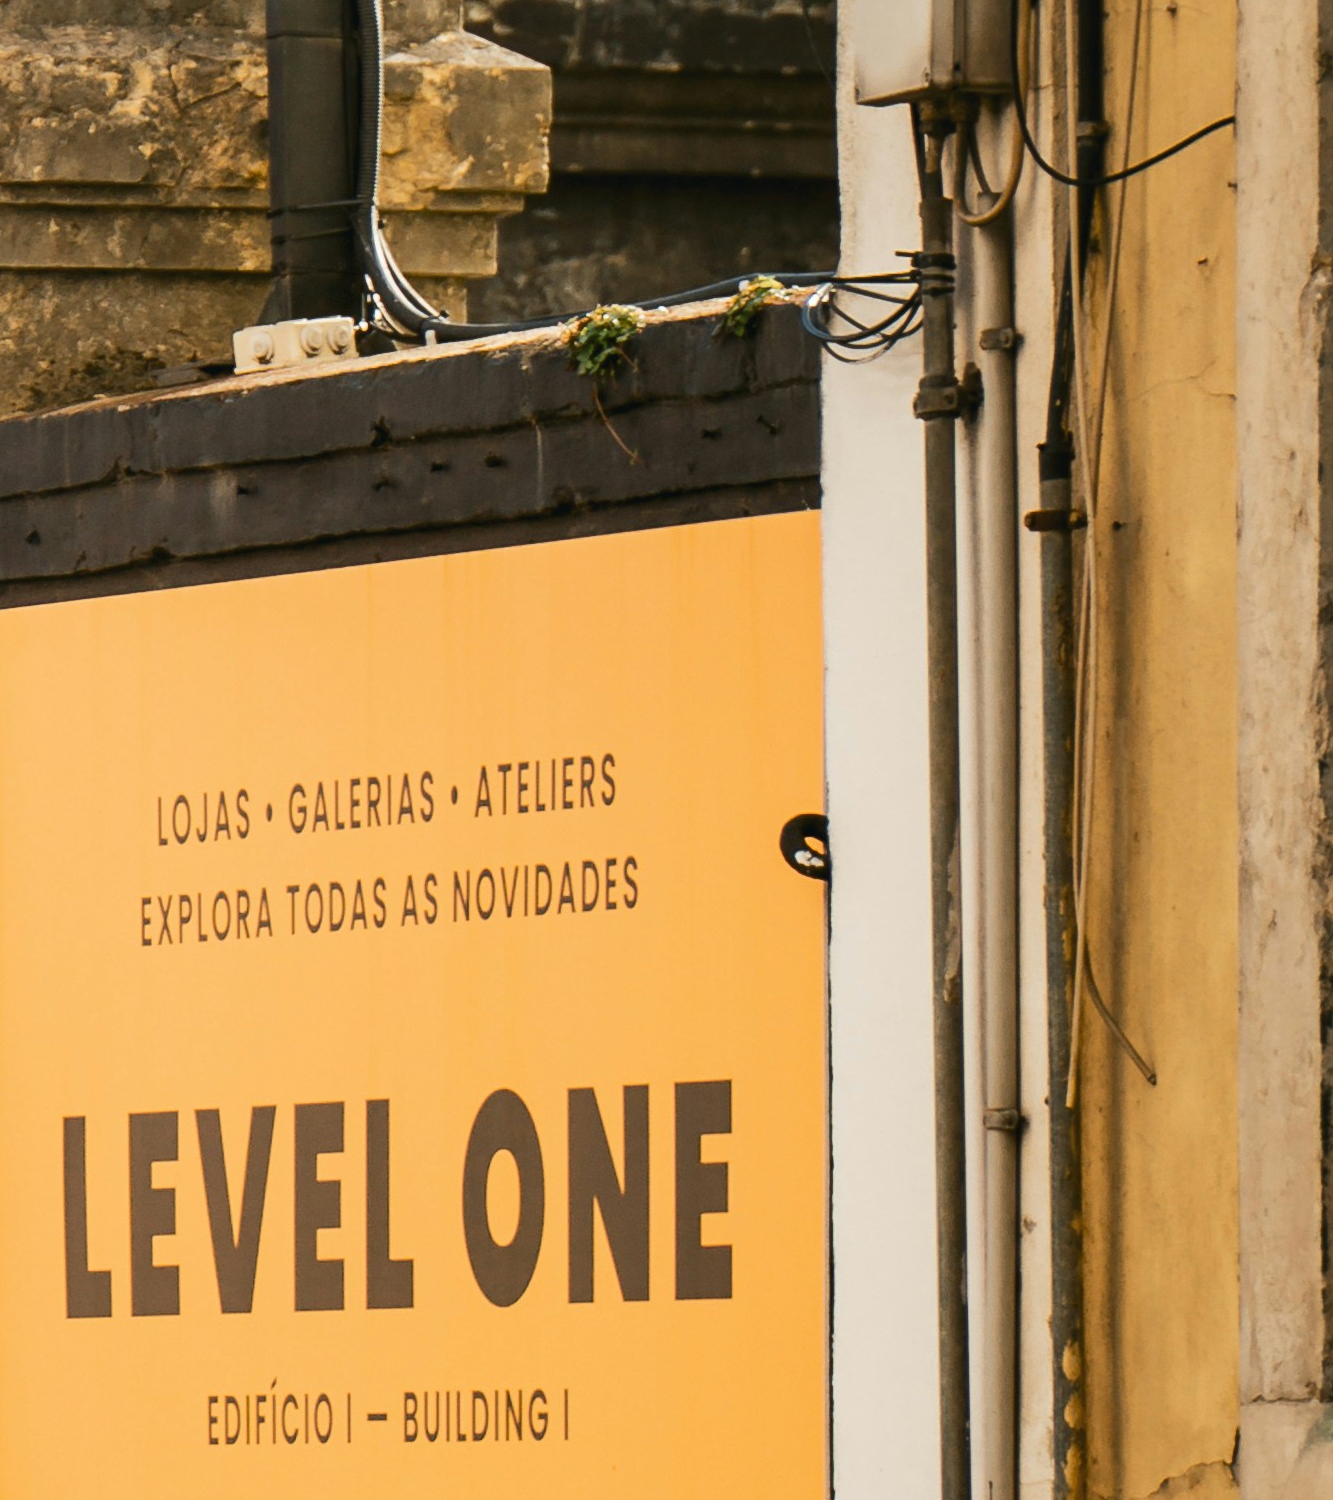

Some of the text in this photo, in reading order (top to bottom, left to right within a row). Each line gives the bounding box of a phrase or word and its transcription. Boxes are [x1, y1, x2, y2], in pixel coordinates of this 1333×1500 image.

[158, 753, 616, 847] LOJAS GALERIAS ATELIERS
[141, 855, 639, 947] EXPLORA TODAS AS NOVIDADES
[62, 1078, 734, 1320] LEVEL ONE
[208, 1378, 333, 1446] EDIFÍCIO
[403, 1388, 549, 1443] BUILDING
